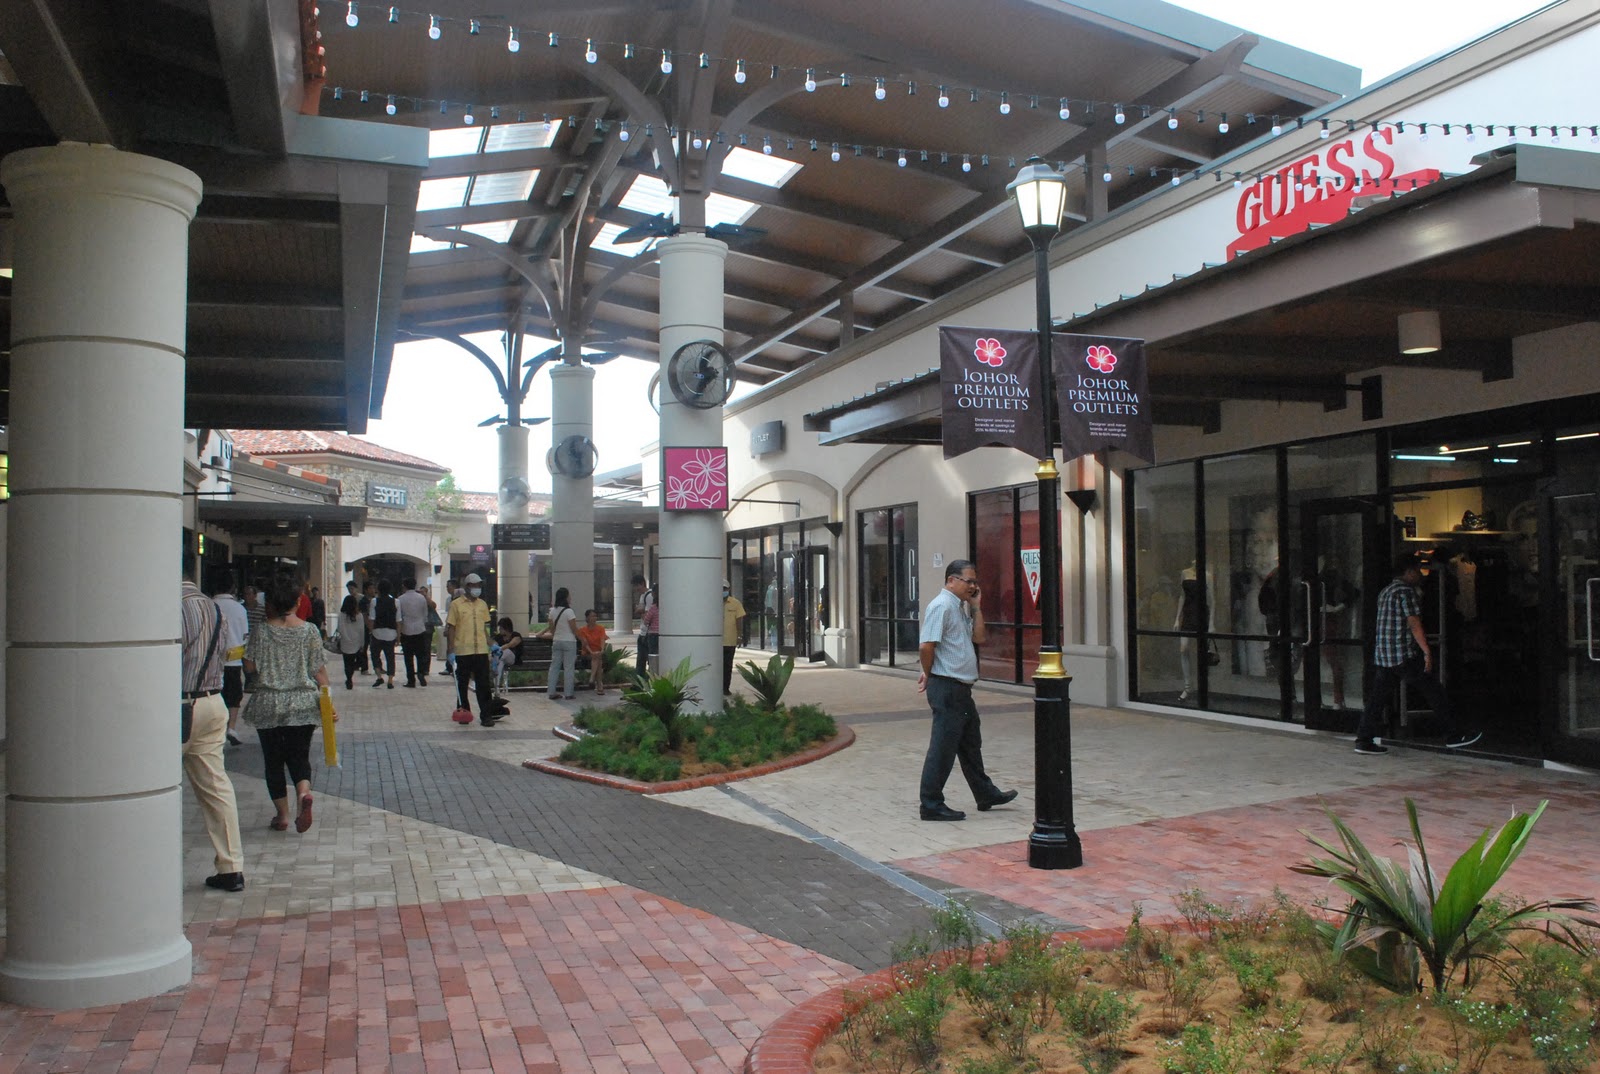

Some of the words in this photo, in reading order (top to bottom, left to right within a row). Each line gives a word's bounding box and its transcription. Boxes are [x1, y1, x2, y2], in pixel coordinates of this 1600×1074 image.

[1236, 127, 1395, 234] GUESS
[953, 383, 1030, 398] PREMIUM
[1069, 389, 1139, 403] PREMIUM
[957, 396, 1029, 411] OUTLETS
[1073, 401, 1139, 416] OUTLETS
[373, 485, 407, 505] ESPRIT
[1022, 551, 1041, 565] GUES
